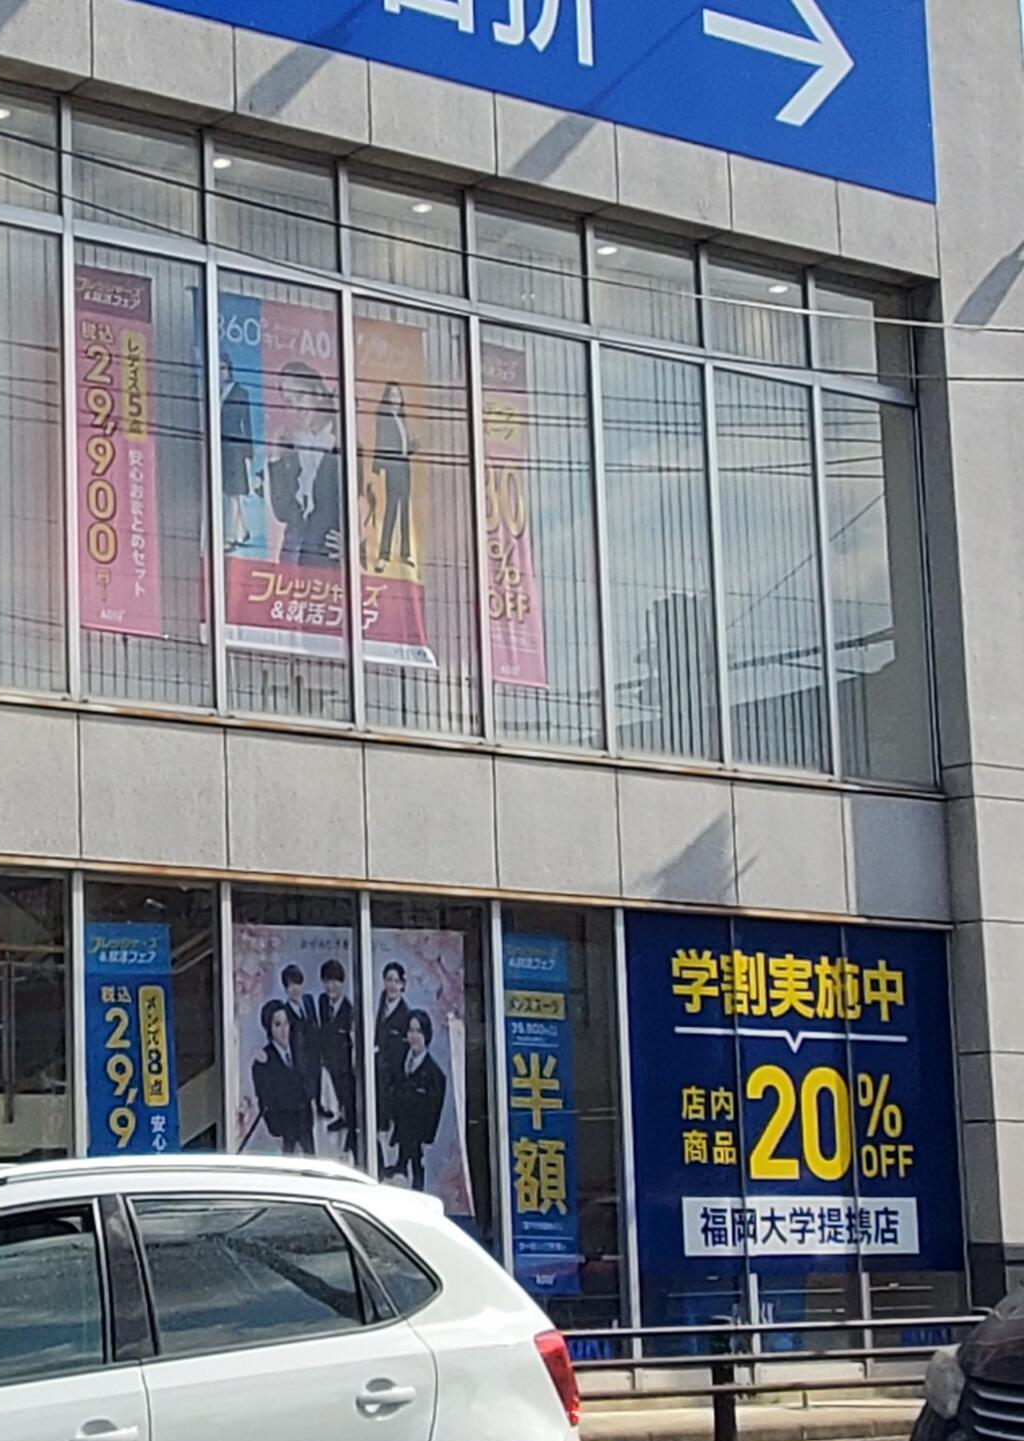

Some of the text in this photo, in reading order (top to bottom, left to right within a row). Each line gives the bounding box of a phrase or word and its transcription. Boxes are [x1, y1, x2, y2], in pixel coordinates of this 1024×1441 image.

[247, 570, 388, 608] フレッシャズ
[270, 598, 379, 631] &就活フア
[670, 948, 906, 1022] 学割実施中
[680, 1085, 735, 1121] 店内
[510, 1052, 568, 1216] 半額
[681, 1129, 737, 1165] 商品
[860, 1144, 915, 1179] OFF
[700, 1206, 900, 1247] 福岡大学提携店
